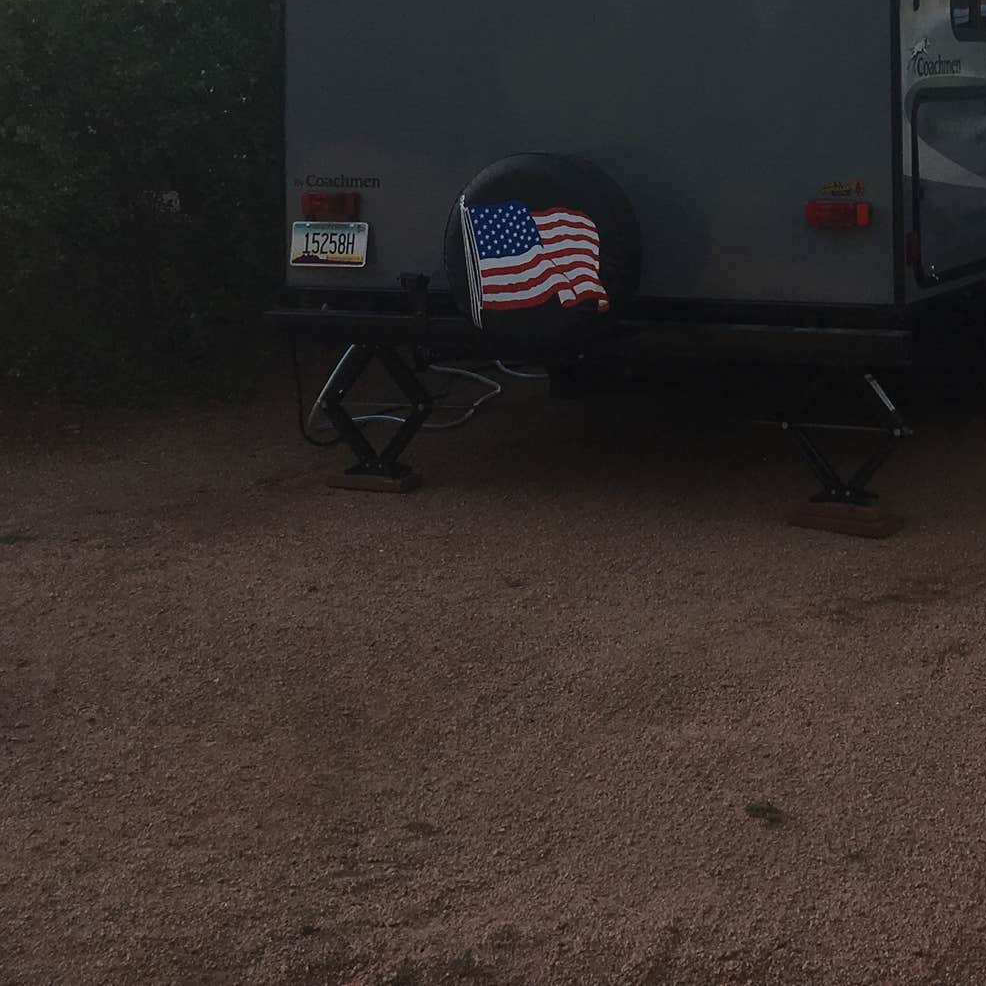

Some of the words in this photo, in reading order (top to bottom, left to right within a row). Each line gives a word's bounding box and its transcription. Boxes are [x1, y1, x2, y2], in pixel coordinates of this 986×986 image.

[916, 54, 962, 77] Coachmen
[305, 174, 380, 188] Coachmen
[302, 232, 356, 255] 15258H
